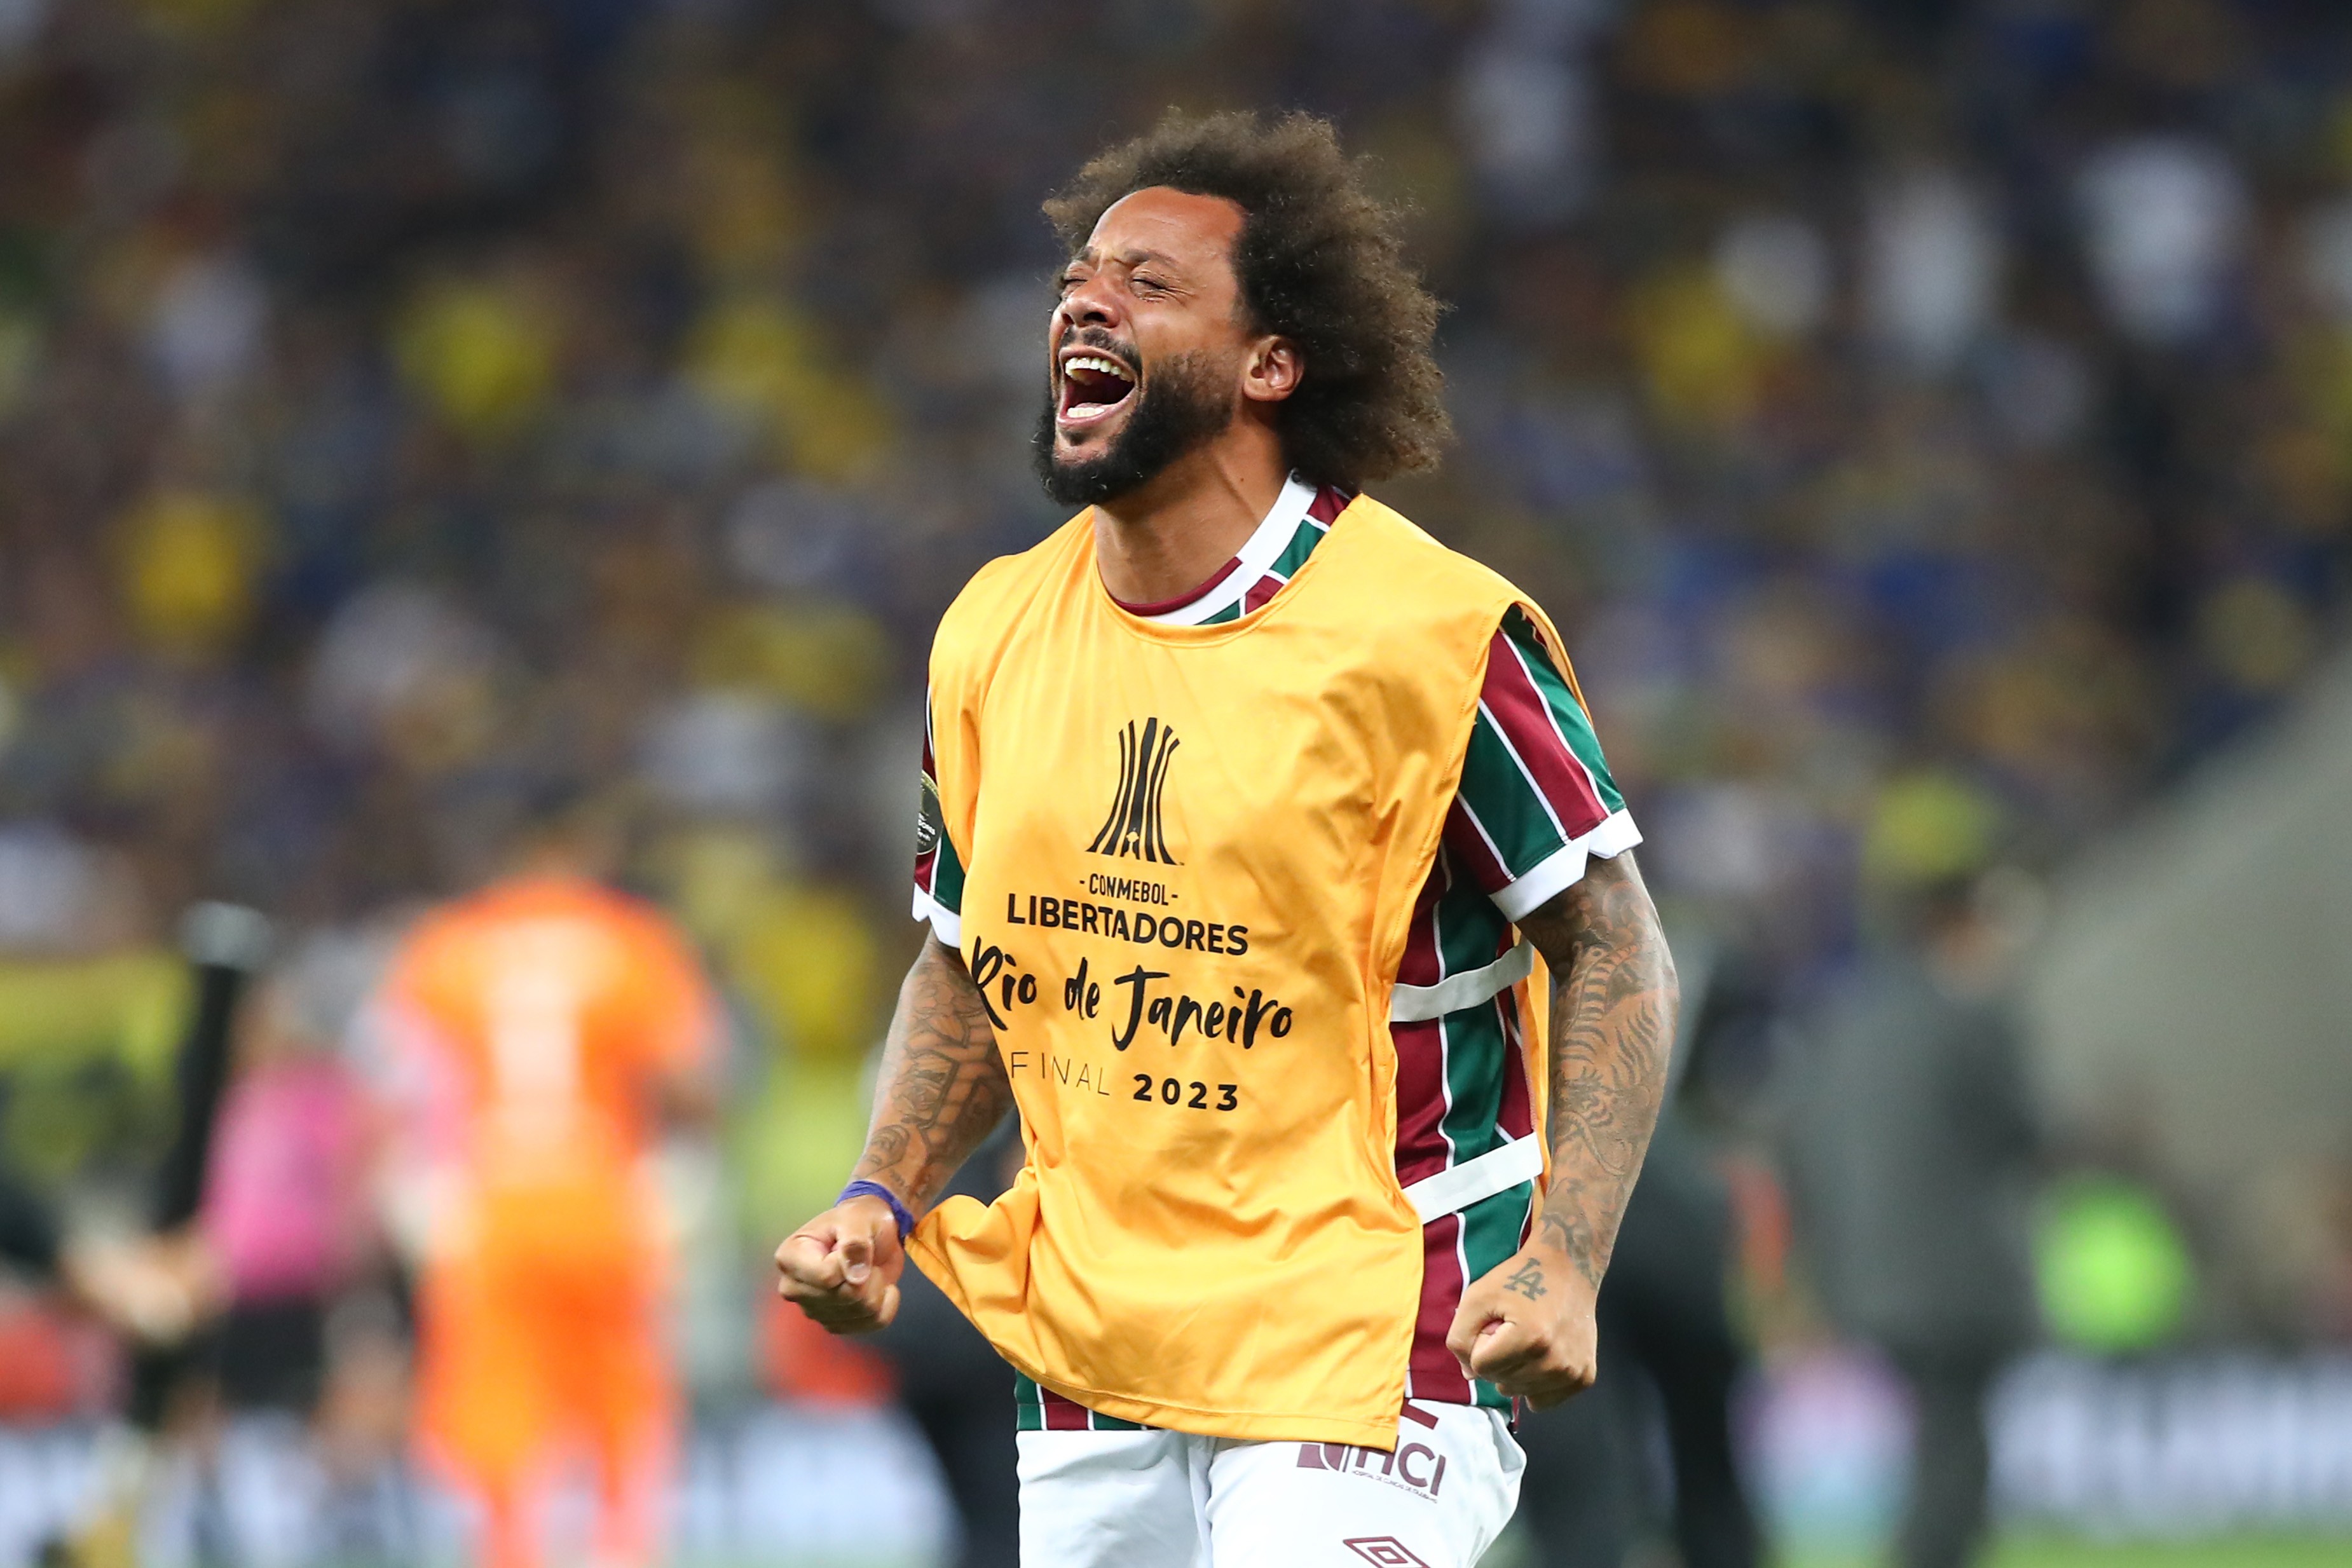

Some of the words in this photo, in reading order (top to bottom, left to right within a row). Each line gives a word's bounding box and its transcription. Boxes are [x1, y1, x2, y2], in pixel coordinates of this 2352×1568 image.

[1089, 873, 1169, 906] CONMEBOL
[1008, 893, 1248, 956] LIBERTADORES
[971, 935, 1037, 1032] Rio
[1064, 957, 1100, 1020] de
[1111, 965, 1293, 1051] Janeiro
[1011, 1051, 1110, 1096] FINAL
[1133, 1074, 1238, 1112] 2023
